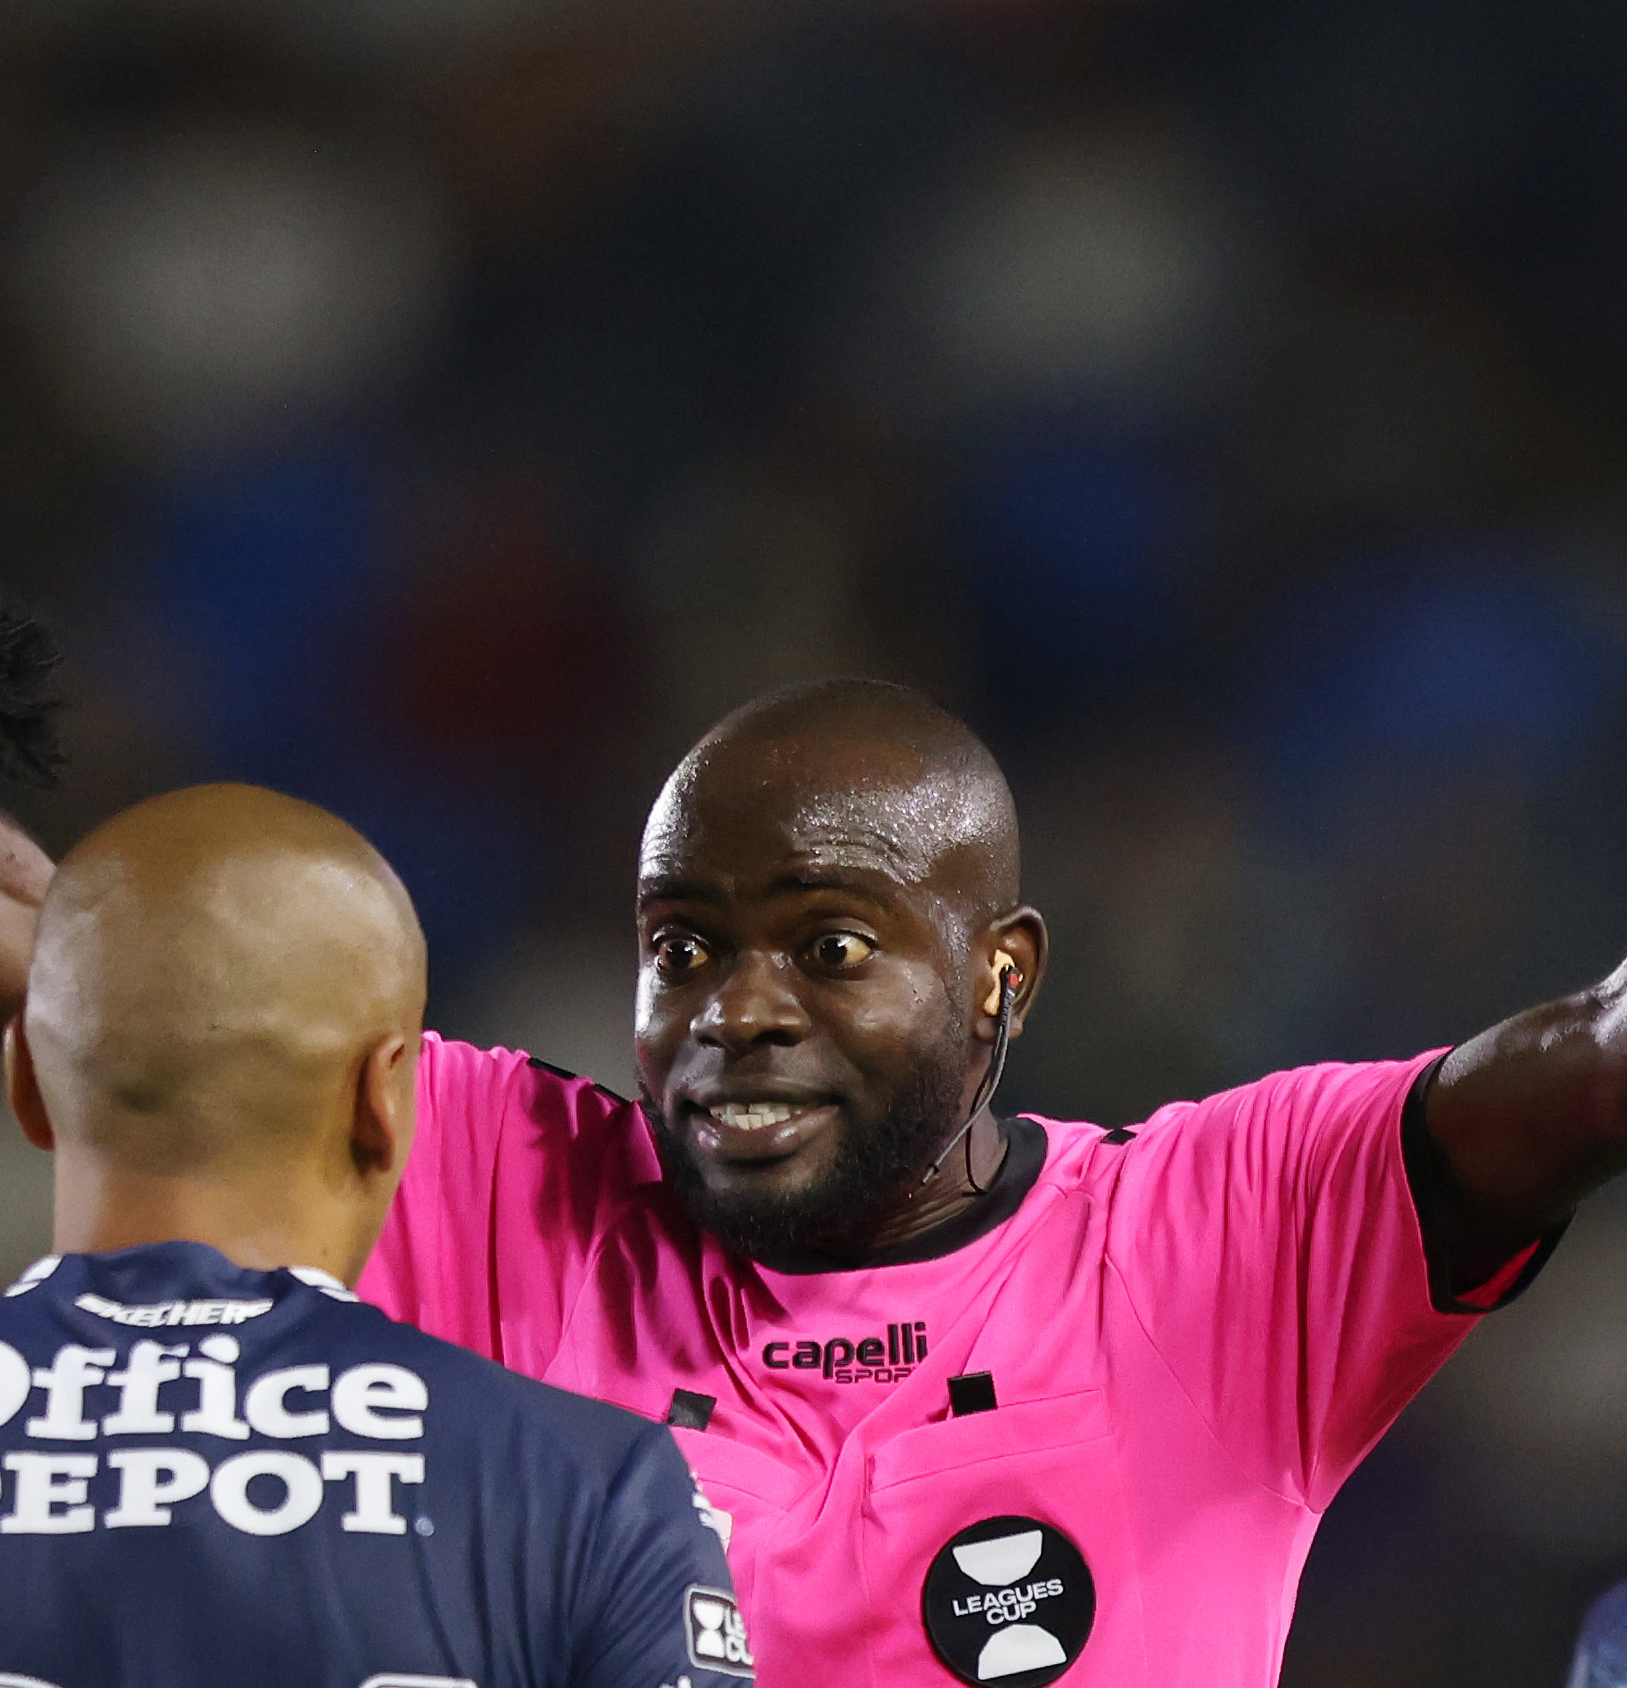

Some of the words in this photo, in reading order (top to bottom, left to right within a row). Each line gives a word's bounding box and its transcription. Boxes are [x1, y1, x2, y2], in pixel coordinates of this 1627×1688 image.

[762, 1320, 929, 1380] capelli
[834, 1367, 913, 1384] SPOR
[952, 1579, 1064, 1617] LEAGUES
[986, 1601, 1037, 1626] CUP
